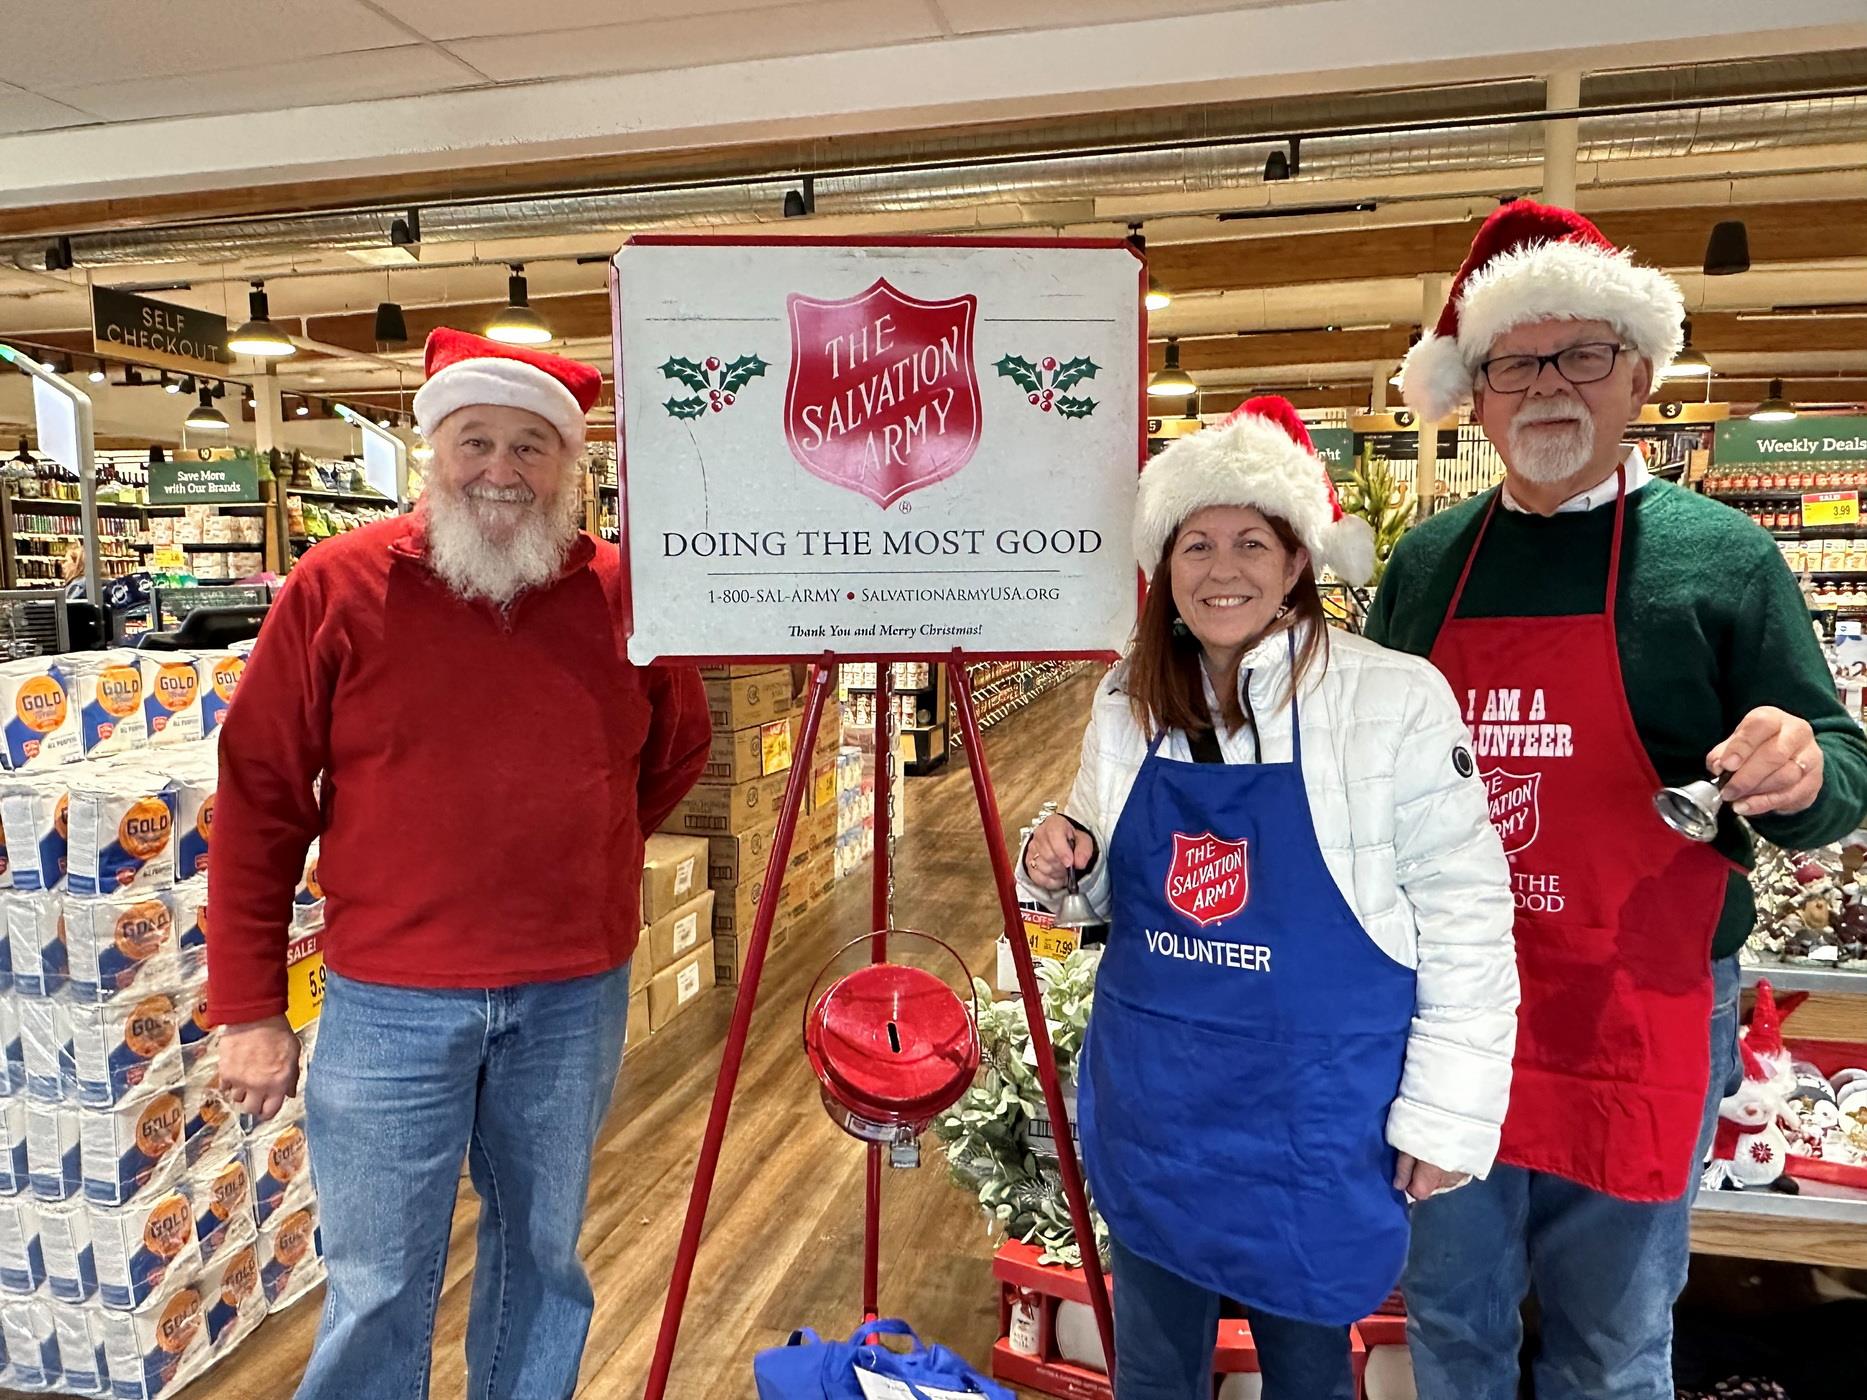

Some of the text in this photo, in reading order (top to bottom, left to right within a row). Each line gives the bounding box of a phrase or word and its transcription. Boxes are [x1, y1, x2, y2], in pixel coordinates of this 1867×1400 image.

[142, 307, 185, 333] SELF
[107, 324, 218, 362] CHECKOUT
[825, 314, 896, 379] THE
[802, 326, 958, 450] SALVATION
[1400, 413, 1410, 424] 4
[1666, 404, 1676, 416] 3
[860, 387, 954, 481] ARMY
[1148, 420, 1157, 431] 5
[1757, 437, 1867, 454] Weekly Deals
[177, 470, 226, 481] Save More
[164, 481, 241, 494] with Our Brands
[1833, 505, 1851, 516] 3.99
[662, 529, 1102, 556] DOING THE MOST GOOD
[708, 586, 1060, 603] 1-800-SAL-ARMY SALVATIONARMYUSA.ORG
[788, 623, 982, 638] Thank You and Merry Christmas!
[102, 679, 139, 696] GOLD
[160, 676, 194, 690] GOLD
[22, 691, 61, 711] GOLD
[1466, 689, 1546, 721] I AM A
[1468, 724, 1574, 757] LUNTEER
[127, 815, 168, 836] GOLD
[1186, 841, 1216, 867] THE
[1172, 848, 1242, 897] SALVATION
[1514, 873, 1560, 892] THE
[1192, 874, 1239, 912] ARMY
[1514, 892, 1564, 912] OOD
[287, 936, 316, 966] SALE!
[1056, 940, 1072, 955] 7.99
[1145, 929, 1271, 972] VOLUNTEER
[150, 1205, 189, 1238] GOLD
